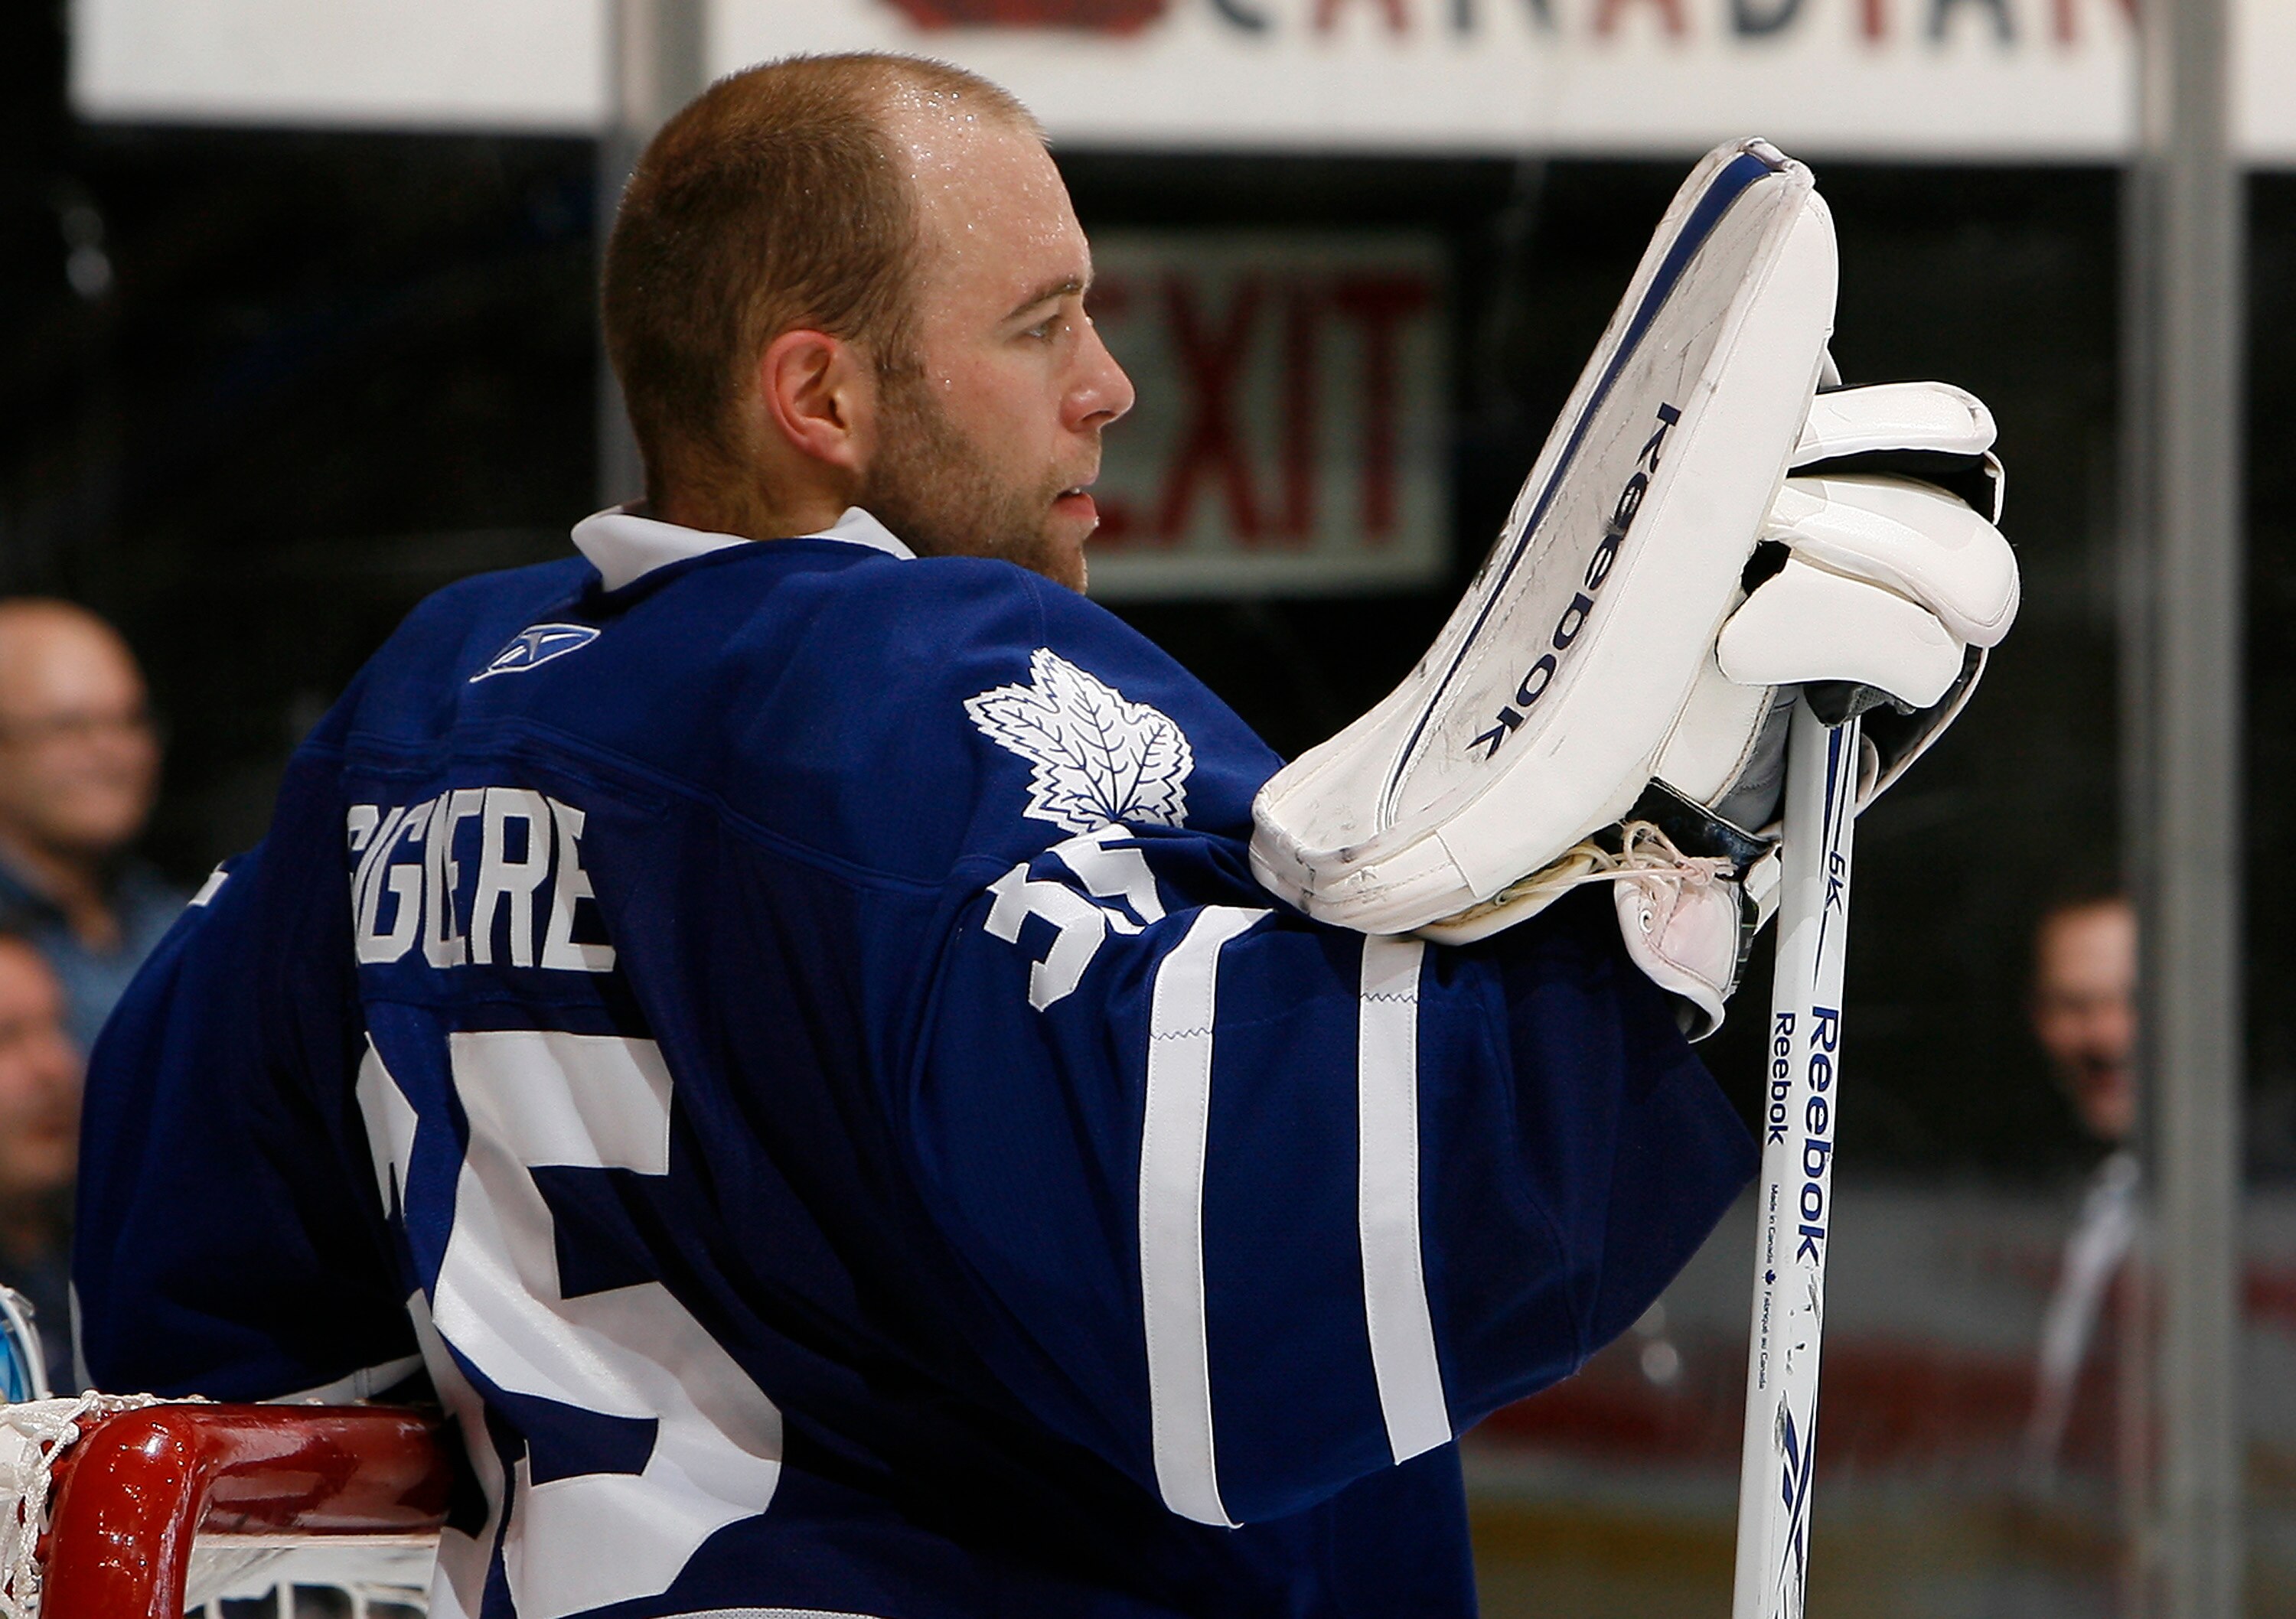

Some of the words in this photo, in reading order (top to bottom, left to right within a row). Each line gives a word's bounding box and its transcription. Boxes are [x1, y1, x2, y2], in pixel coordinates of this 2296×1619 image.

[1465, 402, 1681, 761] Reebok
[1825, 850, 1846, 917] 6K
[1767, 1012, 1796, 1146] Reebok
[1796, 1005, 1840, 1267] Reebok
[1768, 1214, 1776, 1224] in
[1769, 1184, 1779, 1212] Made
[1766, 1226, 1776, 1264] Canada
[1759, 1352, 1769, 1389] Canada
